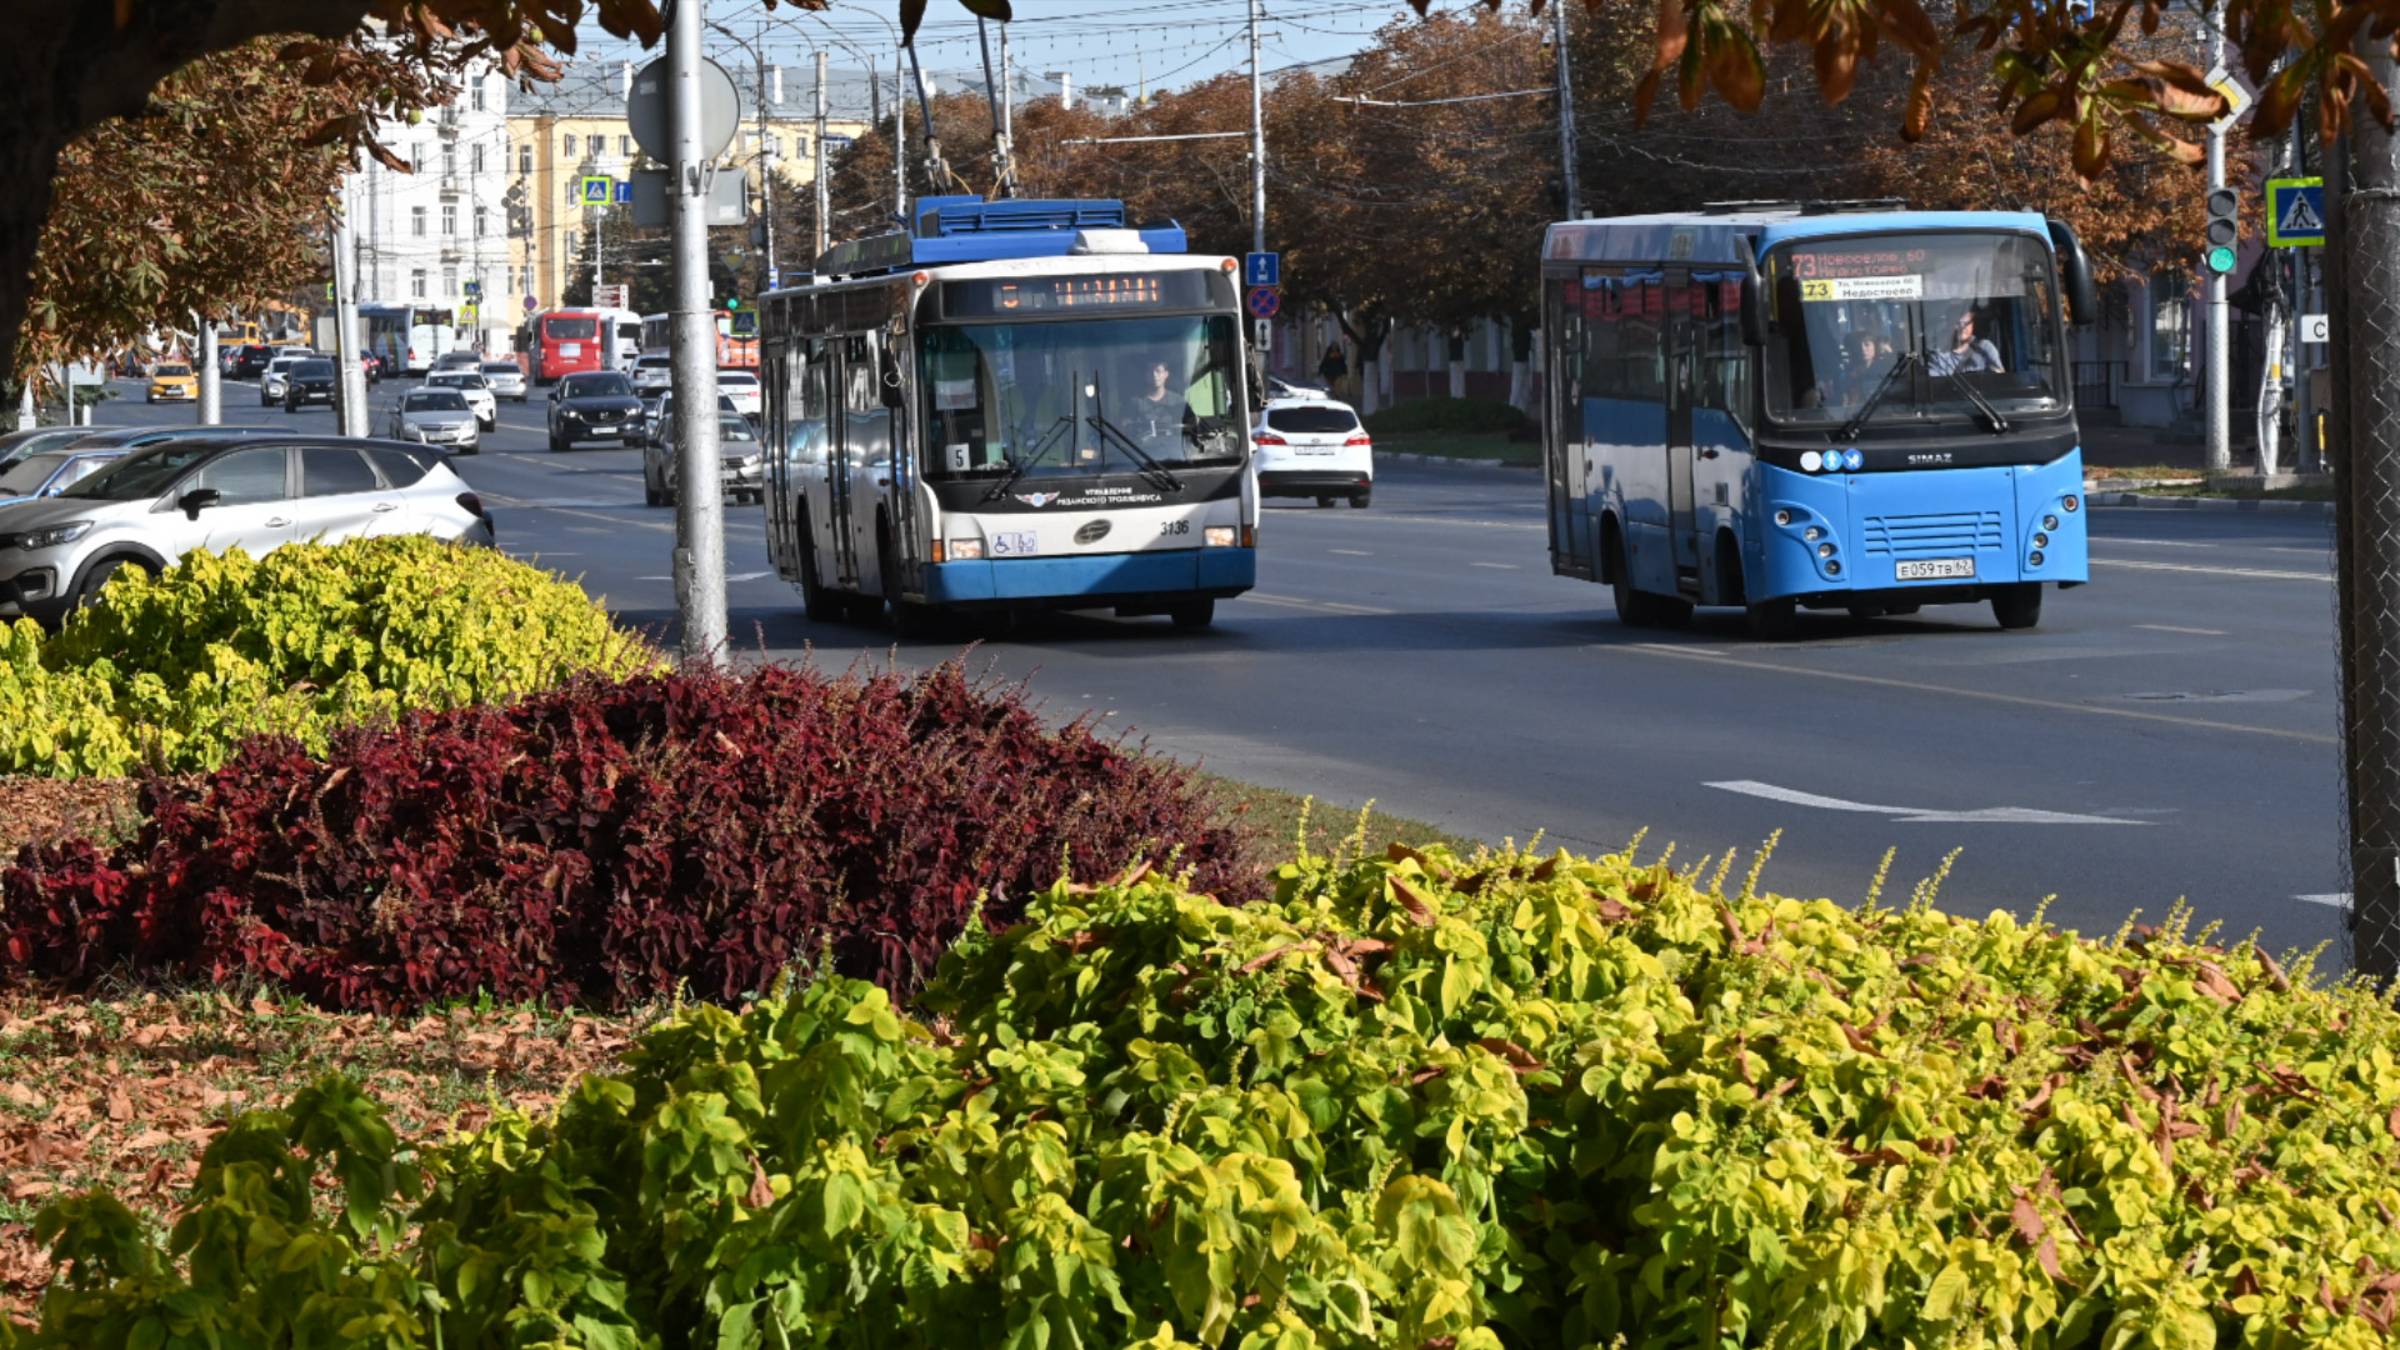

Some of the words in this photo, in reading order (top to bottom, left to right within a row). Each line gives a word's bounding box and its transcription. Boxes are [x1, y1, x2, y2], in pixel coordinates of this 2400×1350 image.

[1791, 253, 1817, 277] 73
[1805, 283, 1829, 297] 73
[955, 449, 965, 468] 5
[1908, 453, 1953, 465] SIMAZ
[1160, 520, 1190, 536] 3136
